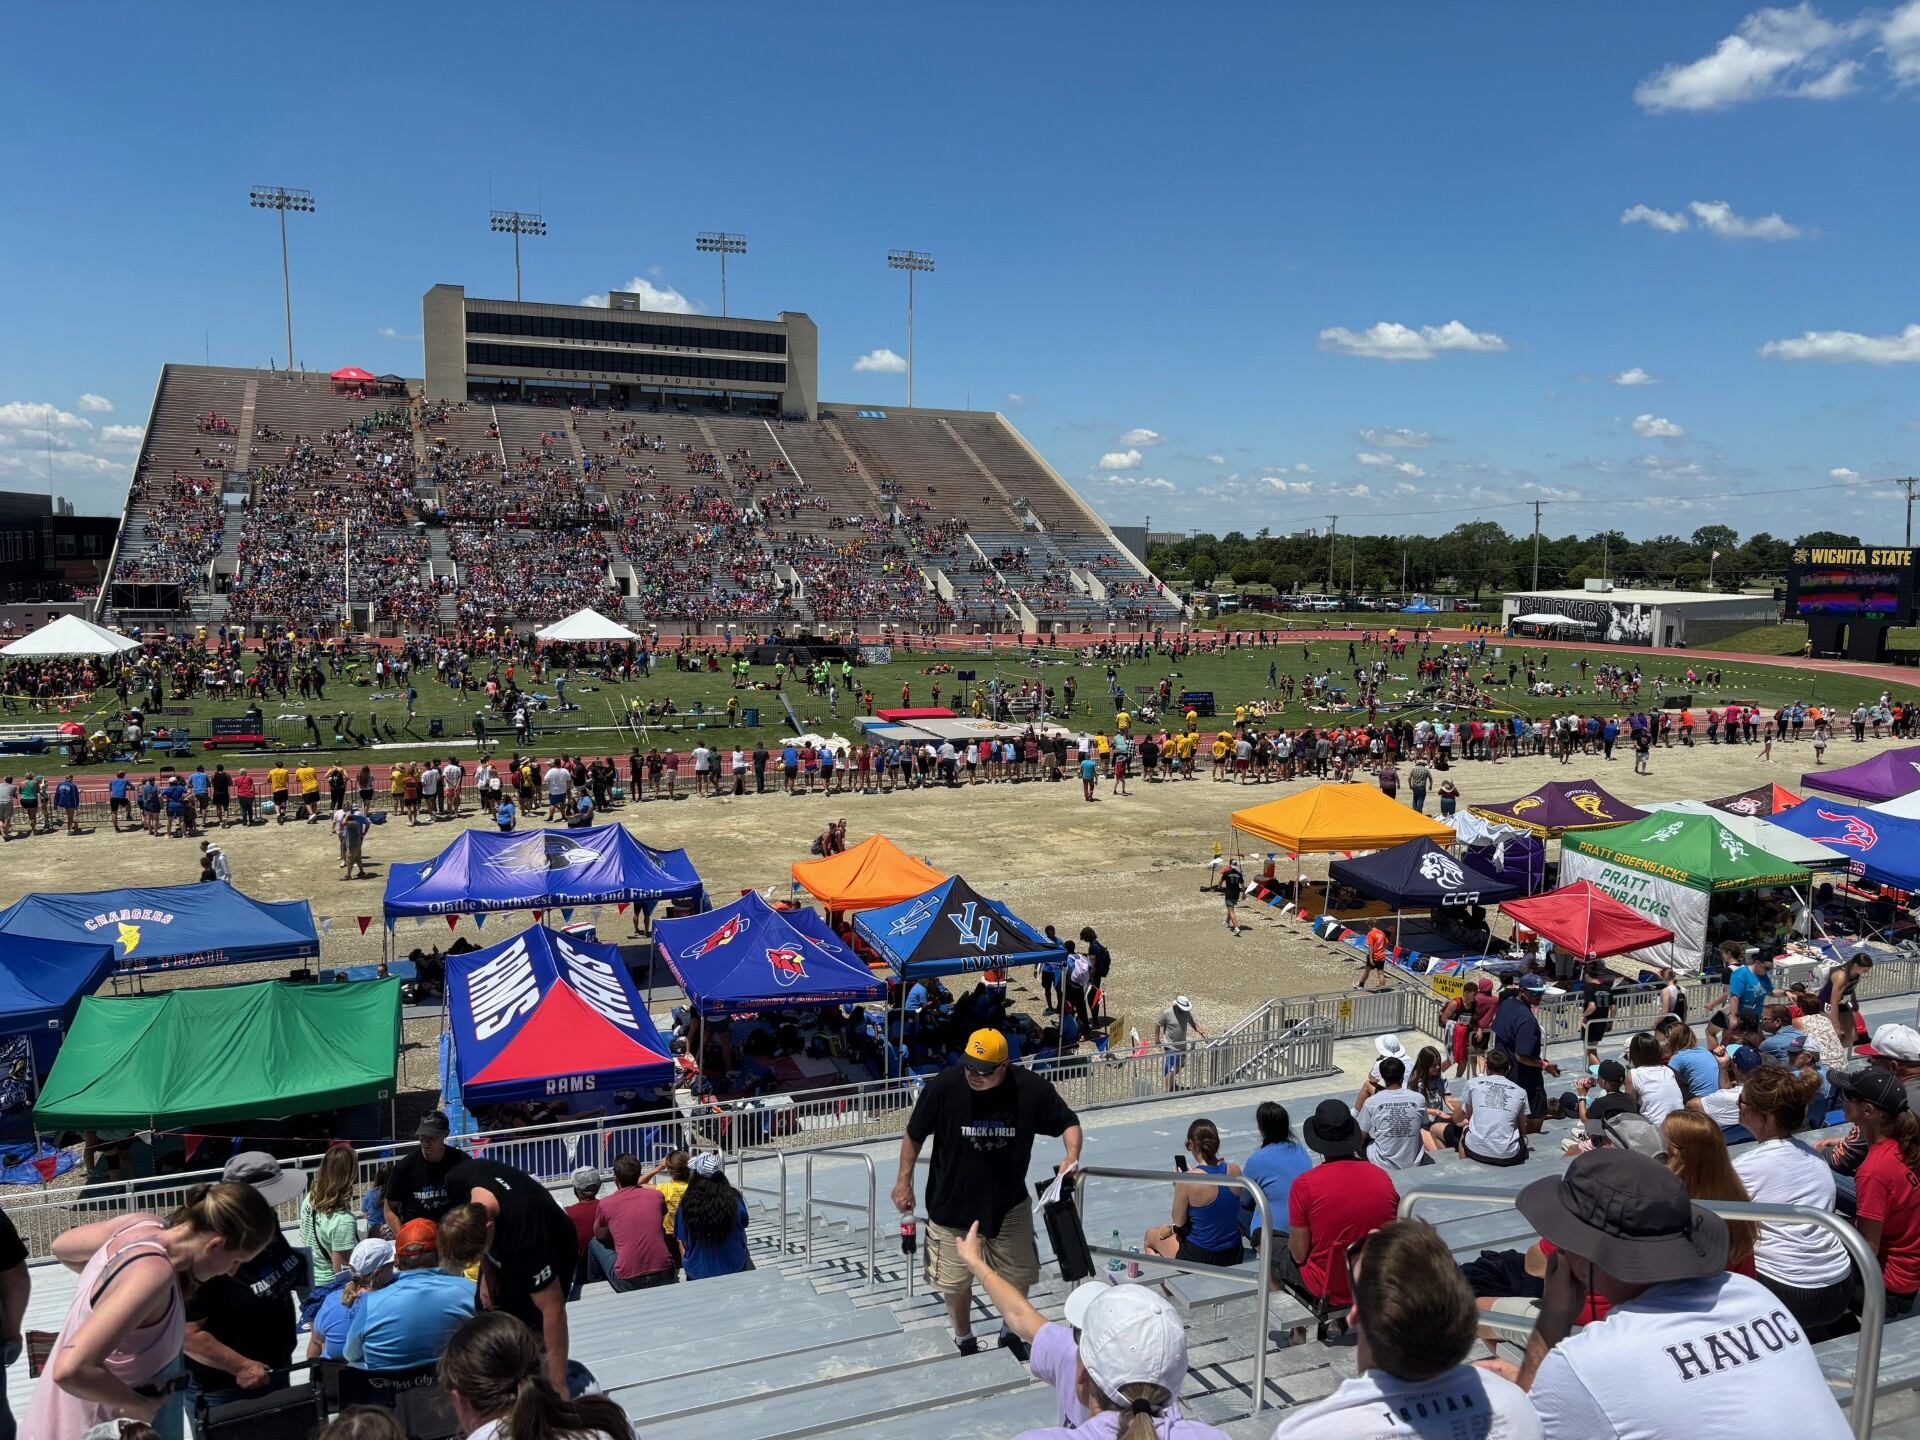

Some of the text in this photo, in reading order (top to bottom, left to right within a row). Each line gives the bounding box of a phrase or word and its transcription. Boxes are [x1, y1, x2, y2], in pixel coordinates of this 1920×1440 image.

[558, 338, 702, 353] WICHITA STATE
[546, 369, 716, 386] CESSNA STADIUM
[1811, 548, 1913, 566] WICHITA STATE
[1521, 596, 1607, 622] SHOCKERS
[1578, 841, 1690, 882] PRATT GREENBACKS
[1600, 868, 1651, 892] PRATT
[1712, 878, 1747, 891] PRATT
[428, 888, 663, 913] Olathe Northwest Track and Field
[1441, 891, 1480, 907] CCA
[84, 908, 174, 931] CHARGERS
[158, 950, 229, 969] TRAIL
[960, 953, 1015, 973] LVXC
[467, 936, 541, 1041] RAMS
[556, 936, 641, 1030] RAMS
[1433, 976, 1464, 988] TEAM CAMP
[1440, 985, 1455, 994] AREA
[545, 1075, 597, 1096] RAMS
[961, 1126, 988, 1137] TRACK
[994, 1127, 1016, 1137] FIELD
[1661, 1308, 1801, 1383] HAVOC
[414, 1374, 433, 1387] City
[1382, 1393, 1475, 1427] TROJAN
